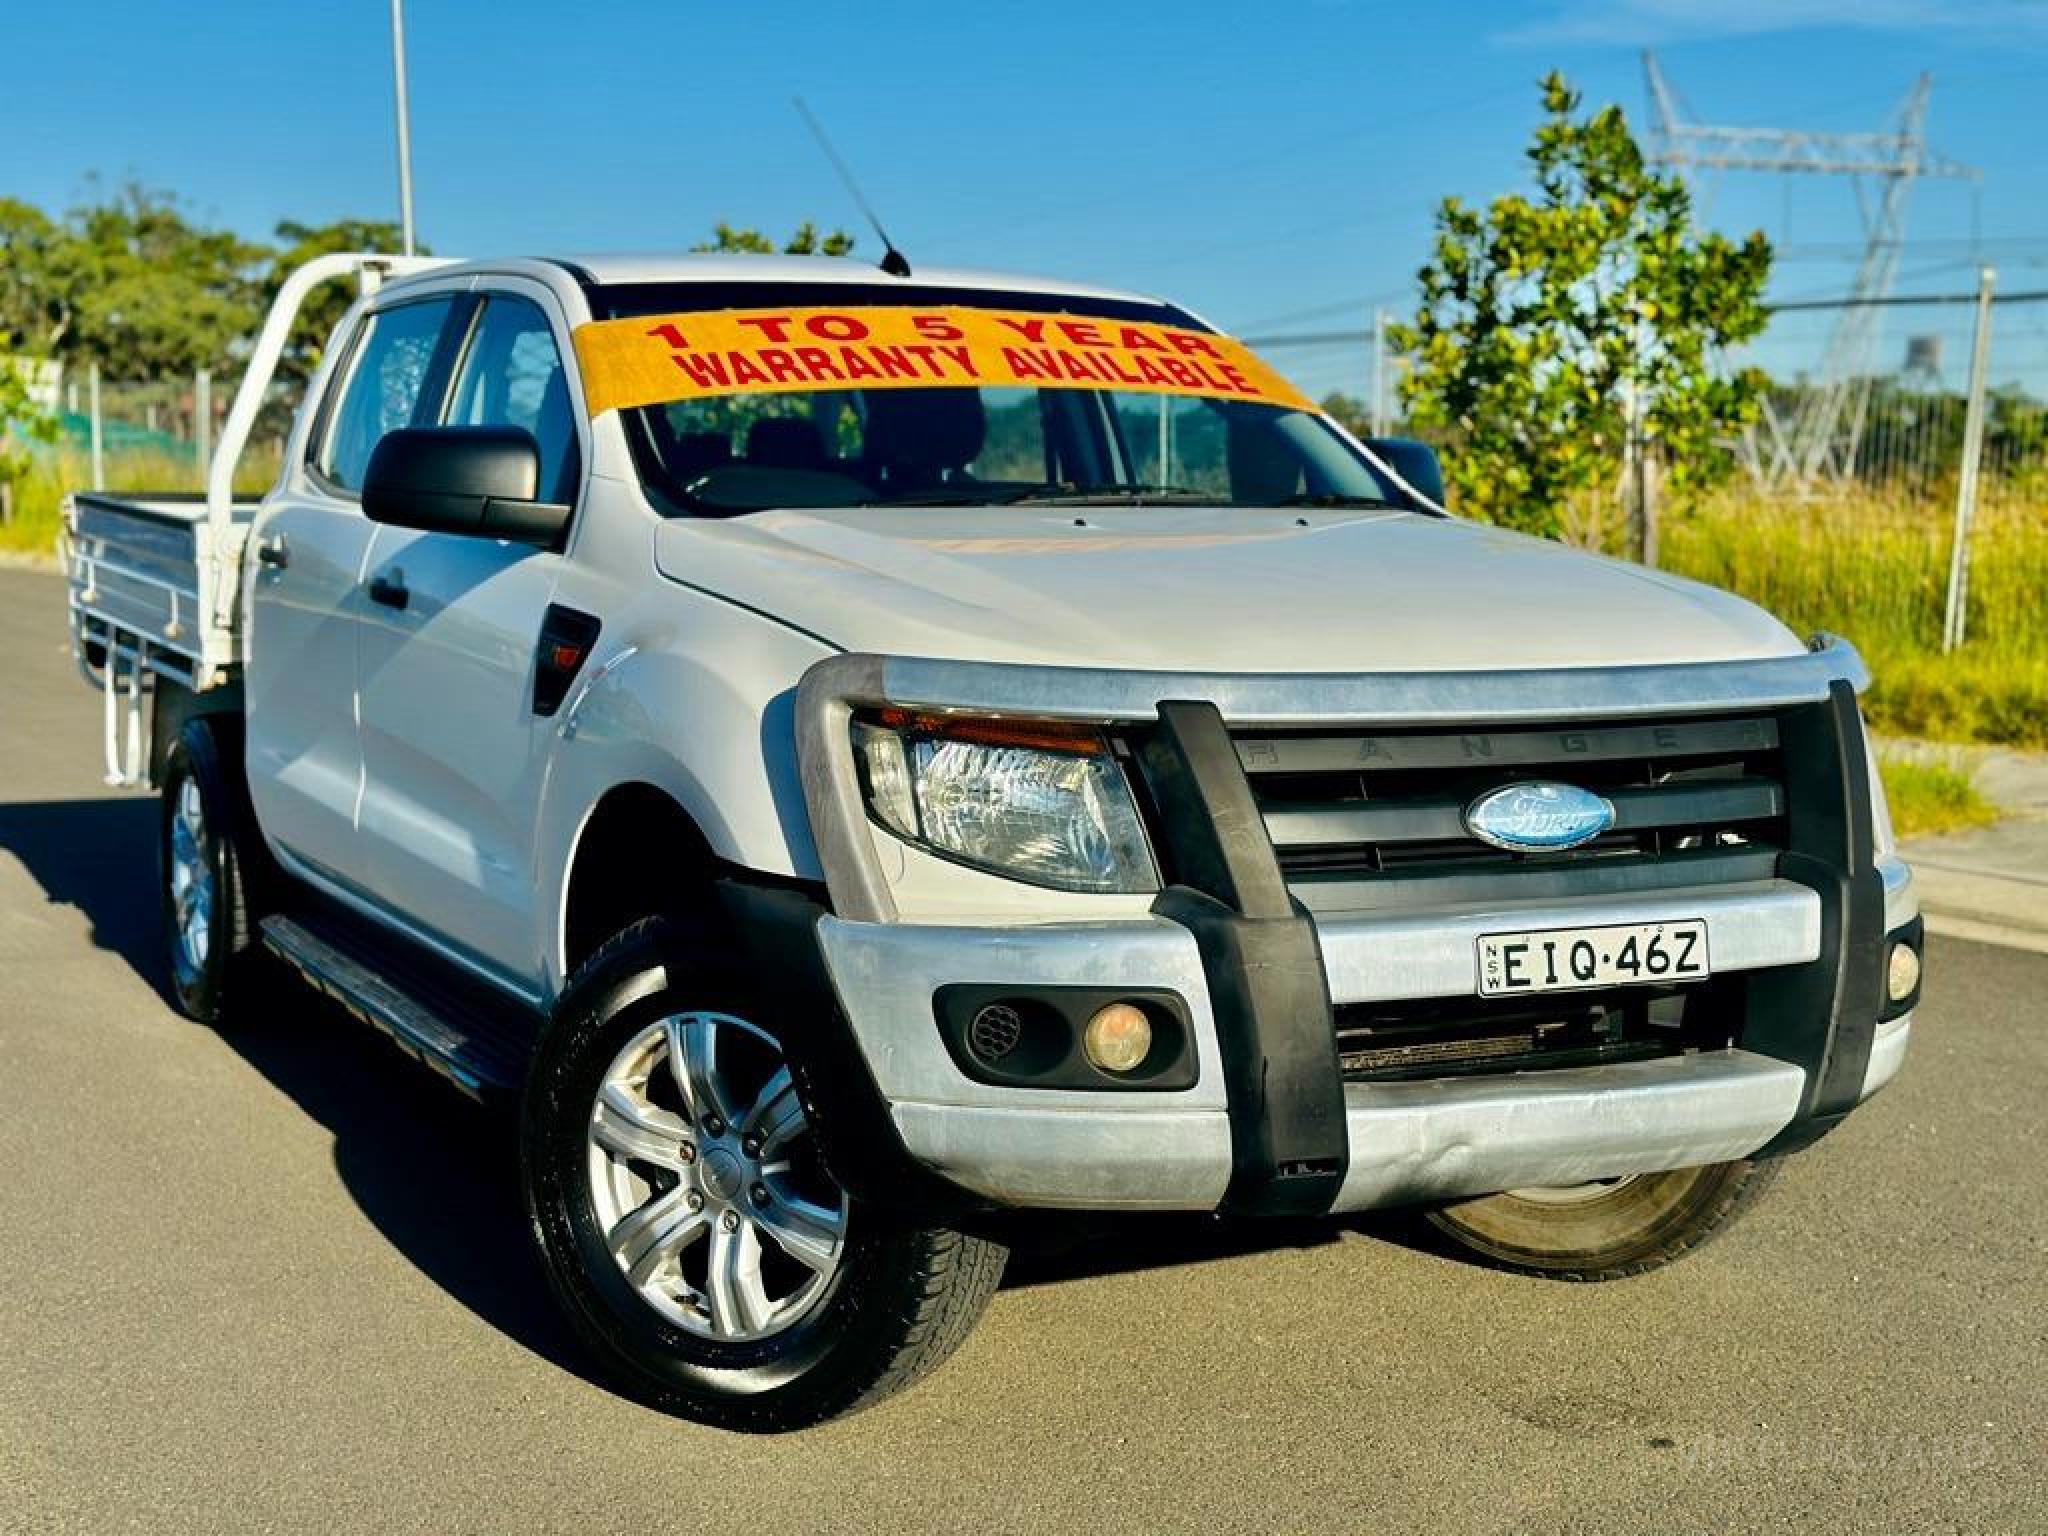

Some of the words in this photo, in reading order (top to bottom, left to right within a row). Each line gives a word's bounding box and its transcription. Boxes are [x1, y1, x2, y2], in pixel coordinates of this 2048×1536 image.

[646, 323, 690, 349] 1
[737, 315, 869, 342] TO
[912, 316, 964, 340] 5
[995, 318, 1224, 360] YEAR
[672, 345, 980, 388] WARRANTY
[1002, 348, 1262, 394] AVAILABLE
